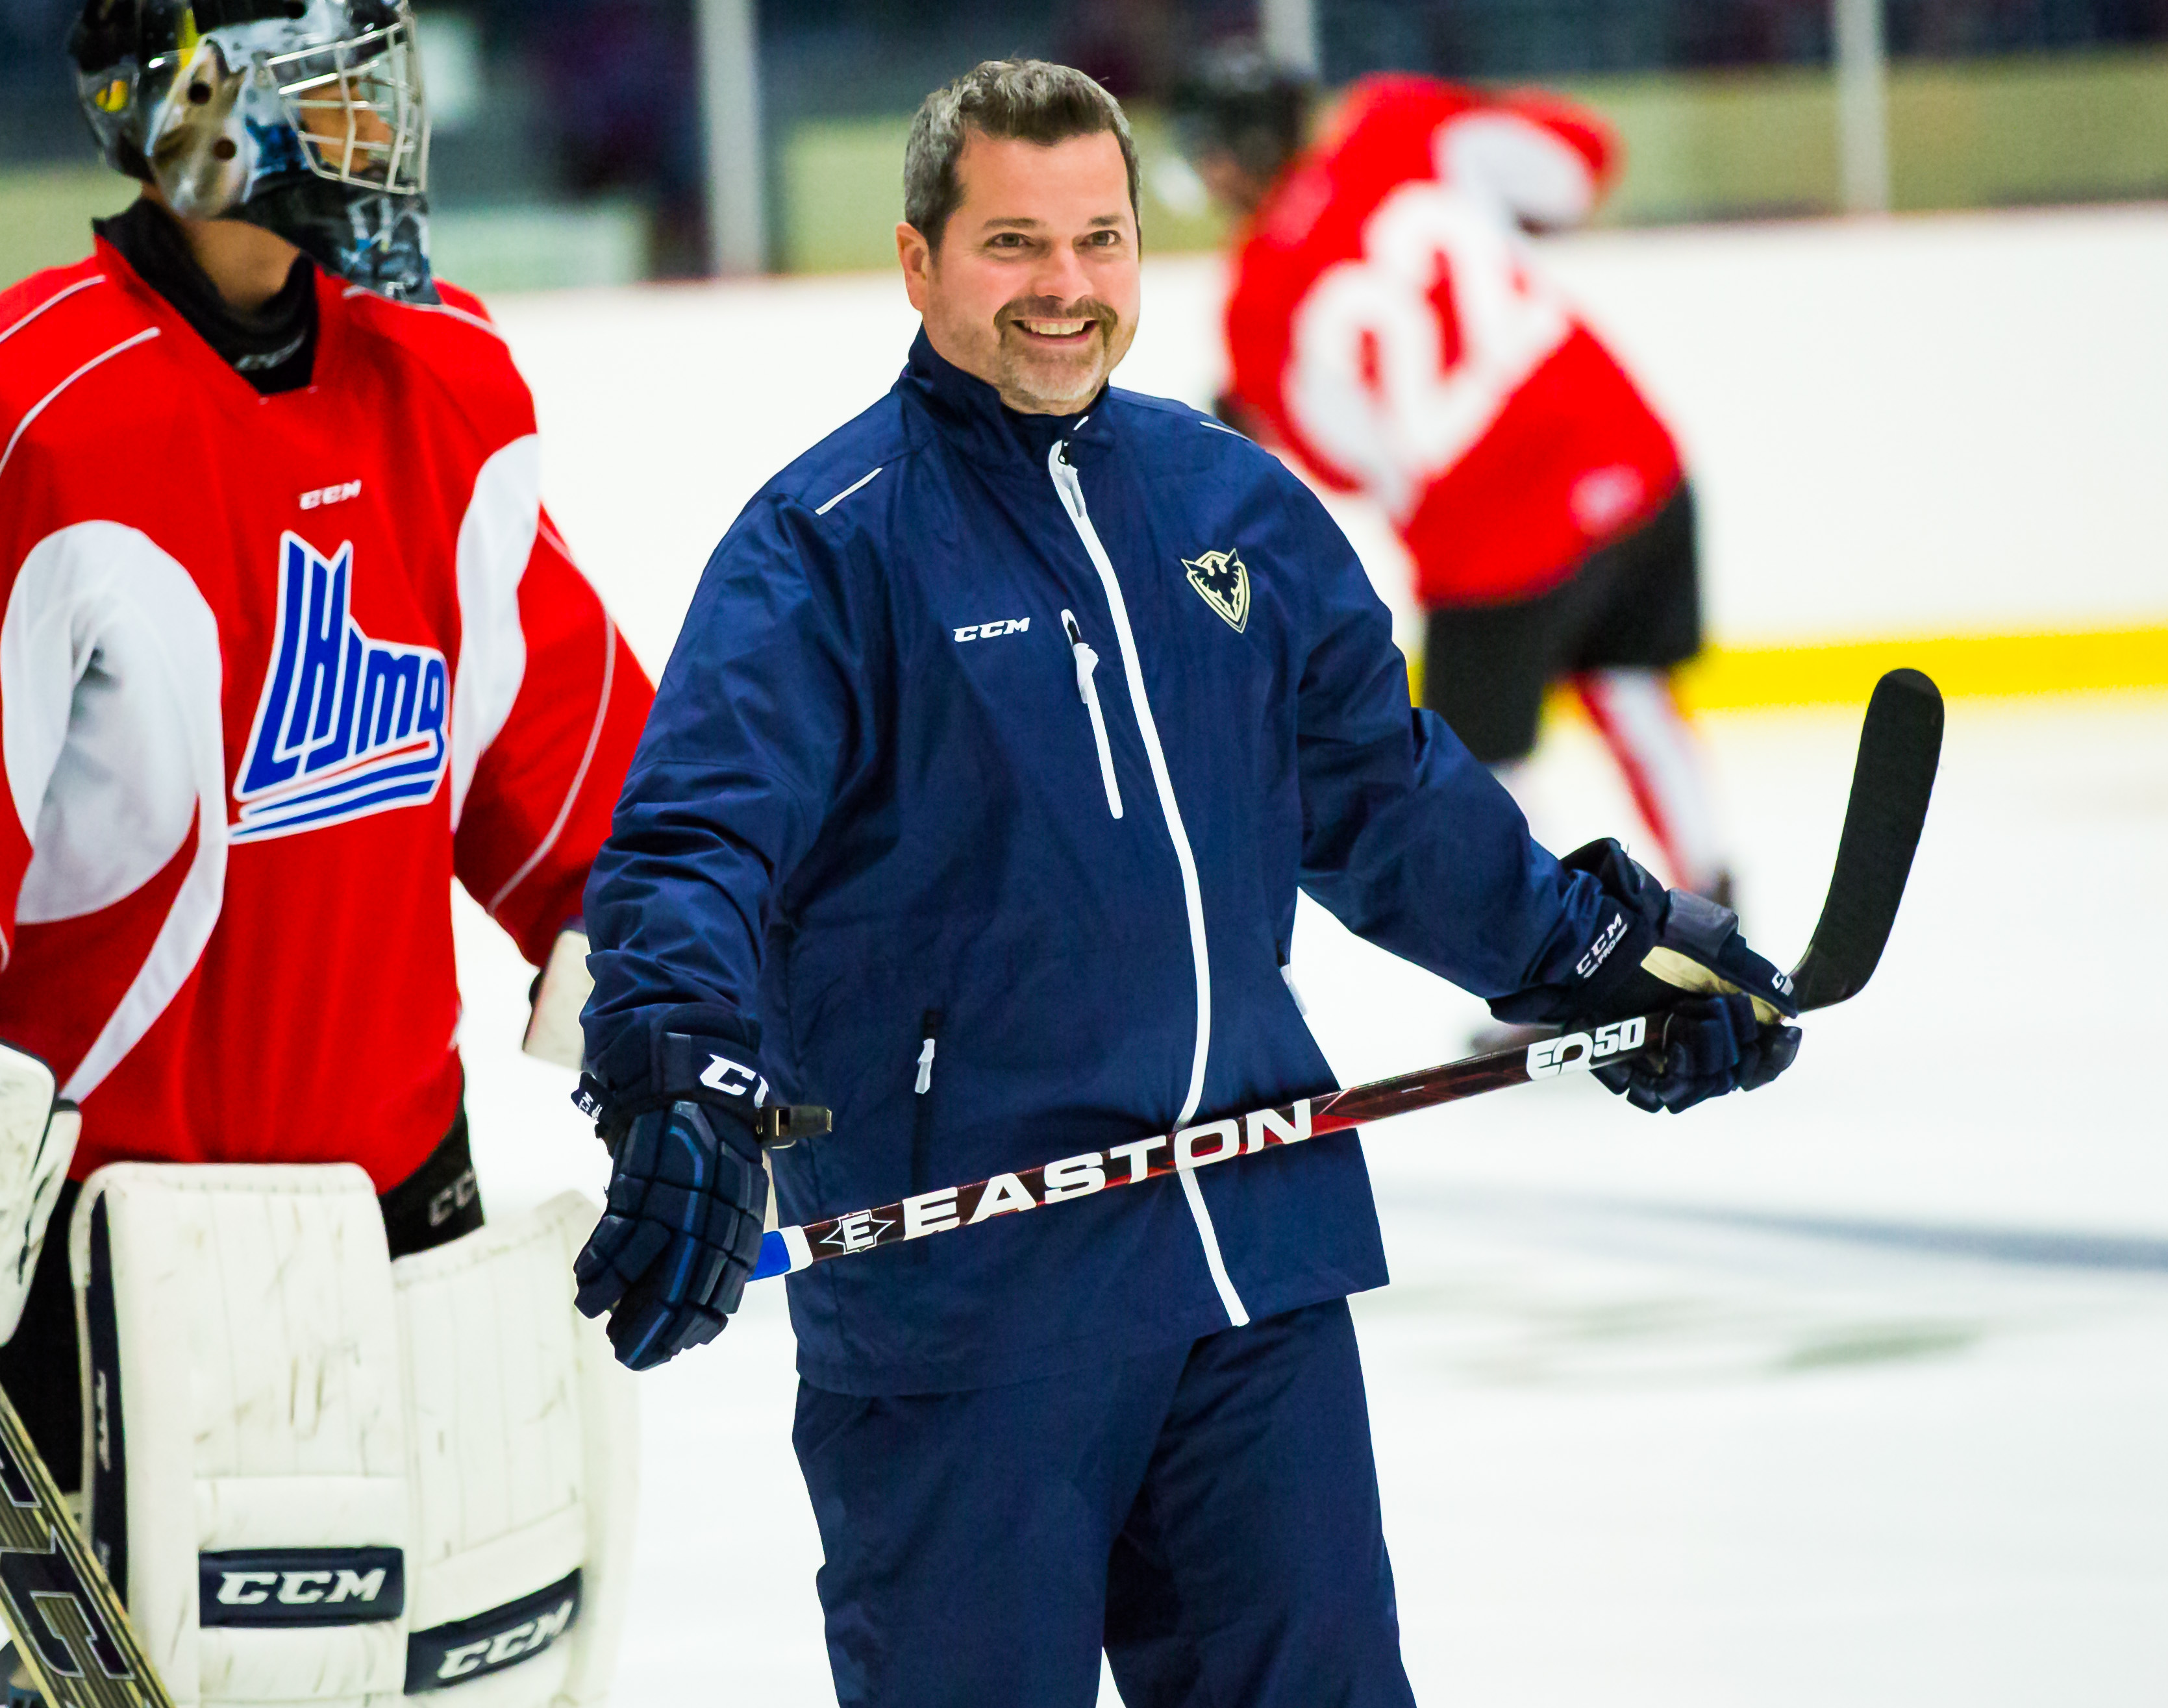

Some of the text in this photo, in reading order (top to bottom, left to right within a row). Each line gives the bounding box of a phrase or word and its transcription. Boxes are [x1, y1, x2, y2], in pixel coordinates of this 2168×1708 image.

[299, 479, 362, 510] CCM
[953, 617, 1030, 643] CCM
[1576, 913, 1623, 975] CCM
[429, 1168, 477, 1226] CC
[902, 1098, 1312, 1241] EASTON
[216, 1568, 386, 1605] CCM
[436, 1601, 573, 1679] CCM
